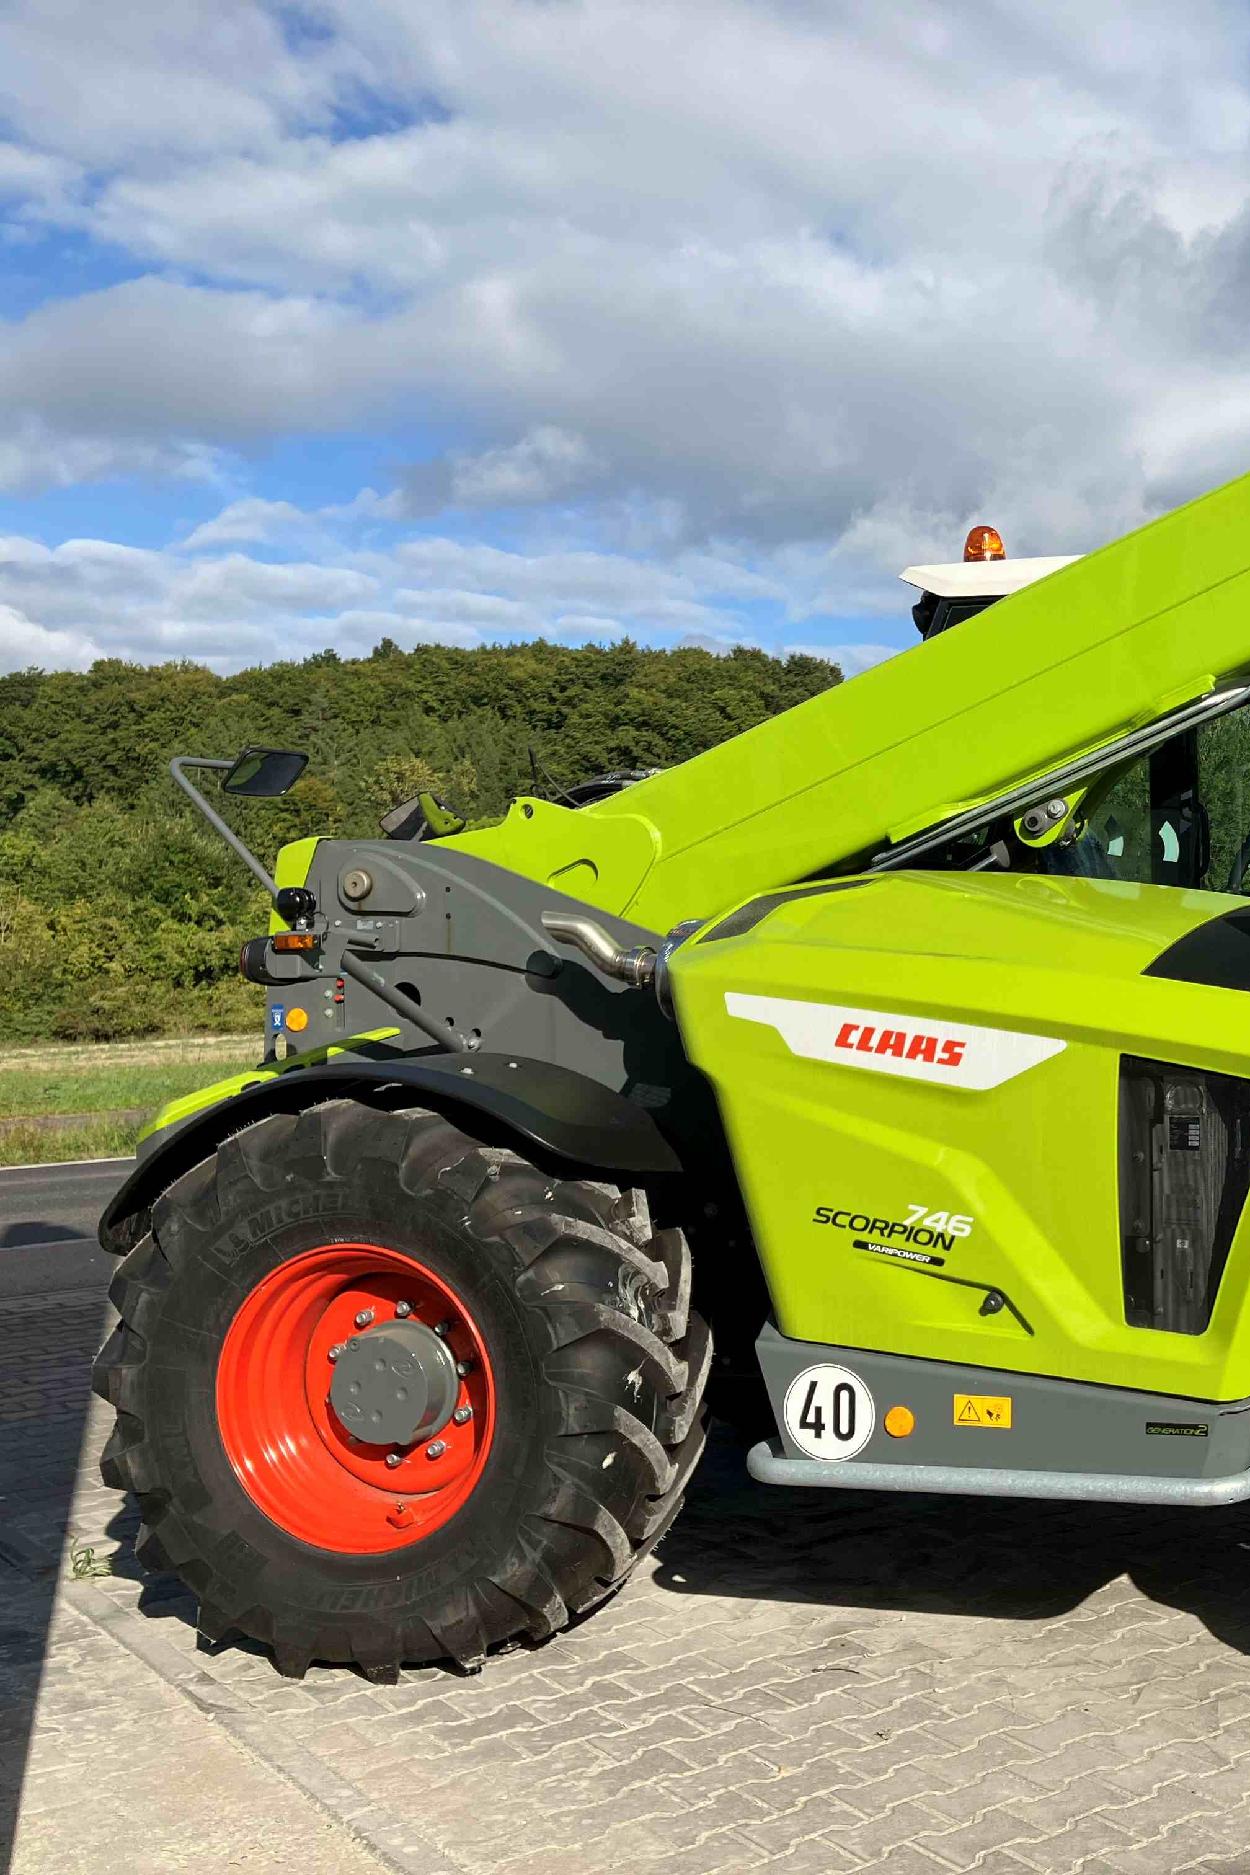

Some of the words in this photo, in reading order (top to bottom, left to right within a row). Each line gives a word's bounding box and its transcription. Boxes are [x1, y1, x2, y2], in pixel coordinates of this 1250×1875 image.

[835, 1023, 967, 1067] CLAAS
[813, 1206, 956, 1252] SCORPION
[902, 1204, 974, 1237] 746
[868, 1243, 931, 1263] VARIPOWER
[799, 1380, 856, 1442] 40
